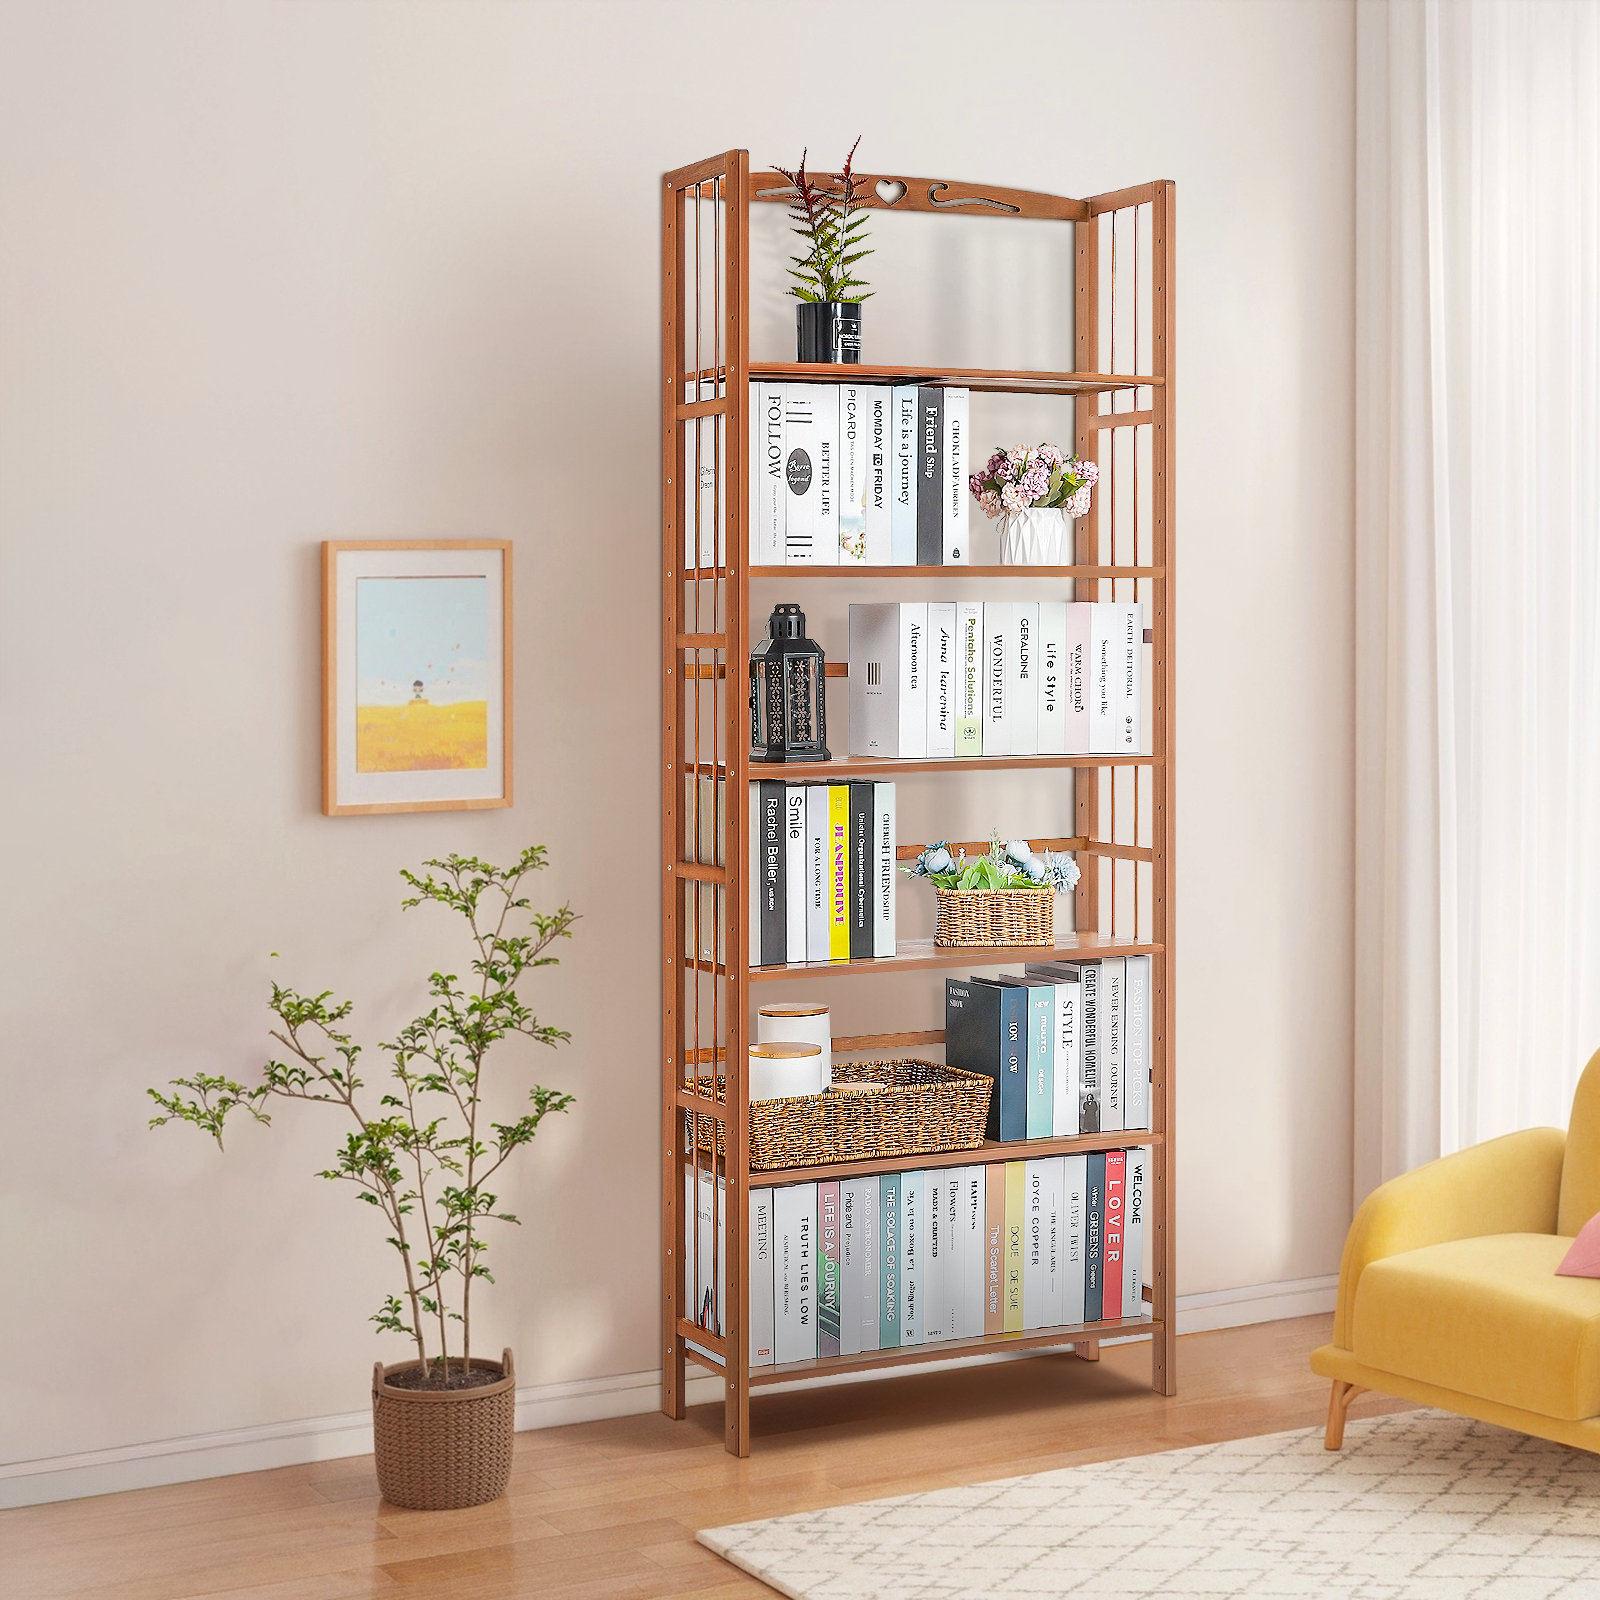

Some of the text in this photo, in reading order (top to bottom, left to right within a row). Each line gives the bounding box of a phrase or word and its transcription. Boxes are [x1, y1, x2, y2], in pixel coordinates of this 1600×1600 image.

[768, 394, 781, 479] FOLLOW
[848, 390, 856, 440] PICARD
[901, 398, 913, 426] Life
[902, 429, 912, 439] is
[874, 400, 882, 509] MOMDAY TO FRIDAY
[925, 406, 938, 478] Friend Ship
[952, 420, 960, 518] CHOKLADFABRIKEN
[822, 442, 830, 515] BETTER LIFE
[898, 453, 912, 506] journey
[911, 623, 920, 673] Afternoon
[940, 628, 950, 663] Anna
[968, 618, 976, 663] Pentaho
[1020, 618, 1028, 679] GERALDINE
[967, 667, 976, 715] Solutions
[992, 634, 1003, 722] WONDERFUL
[1045, 643, 1056, 712] Life Style
[1074, 644, 1083, 713] WARM CHORD
[1099, 639, 1108, 716] Something you like
[767, 798, 778, 842] Rachel
[789, 796, 802, 838] Smile
[766, 847, 778, 886] Beller,
[857, 838, 865, 887] Organizational
[882, 813, 890, 920] CHERISH FRIENDSHIP
[857, 889, 865, 927] Cybernetics
[1062, 1000, 1073, 1050] STYLE
[1085, 969, 1096, 1088] CREATE WONDERFUL HOMELIFE
[1132, 979, 1142, 1106] FASHION TOP PICKS
[845, 1192, 854, 1213] Pride
[846, 1213, 854, 1229] and
[907, 1208, 914, 1216] la
[949, 1181, 958, 1222] Flowers
[1107, 1180, 1121, 1262] LOVER
[1132, 1165, 1144, 1224] WELCOME
[758, 1205, 767, 1260] MEETING
[824, 1194, 835, 1309] LIFE IS A JOURNY
[864, 1188, 872, 1276] RADIO ASTRONOMER
[909, 1219, 914, 1230] ou
[1070, 1192, 1079, 1263] OLIVER TWIST
[1089, 1211, 1099, 1258] GREENS
[801, 1217, 809, 1325] TRUTH LIES LOW
[887, 1187, 895, 1321] THE SOLACE OF SOAKING
[907, 1259, 914, 1270] La
[989, 1225, 1000, 1314] The Scarlet Letter
[1010, 1226, 1019, 1310] DOUE DE SUIE
